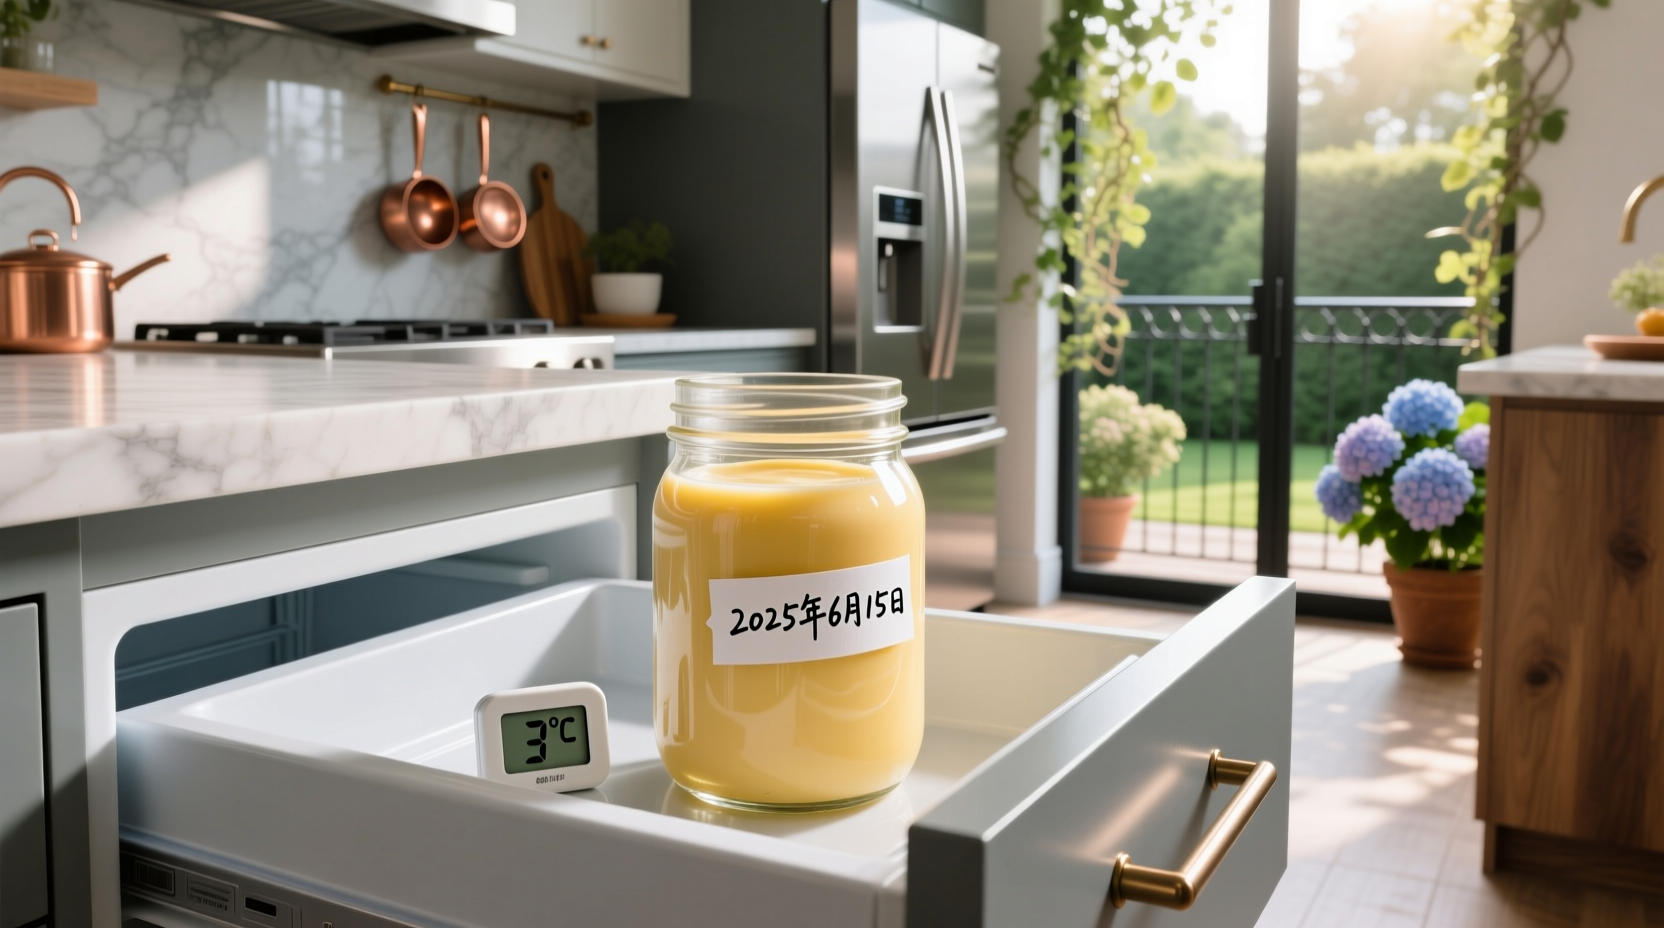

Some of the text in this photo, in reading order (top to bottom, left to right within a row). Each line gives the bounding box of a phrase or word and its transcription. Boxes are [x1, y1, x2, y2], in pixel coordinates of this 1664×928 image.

[730, 587, 904, 641] 2025年6月15日
[525, 716, 577, 764] 3°C
